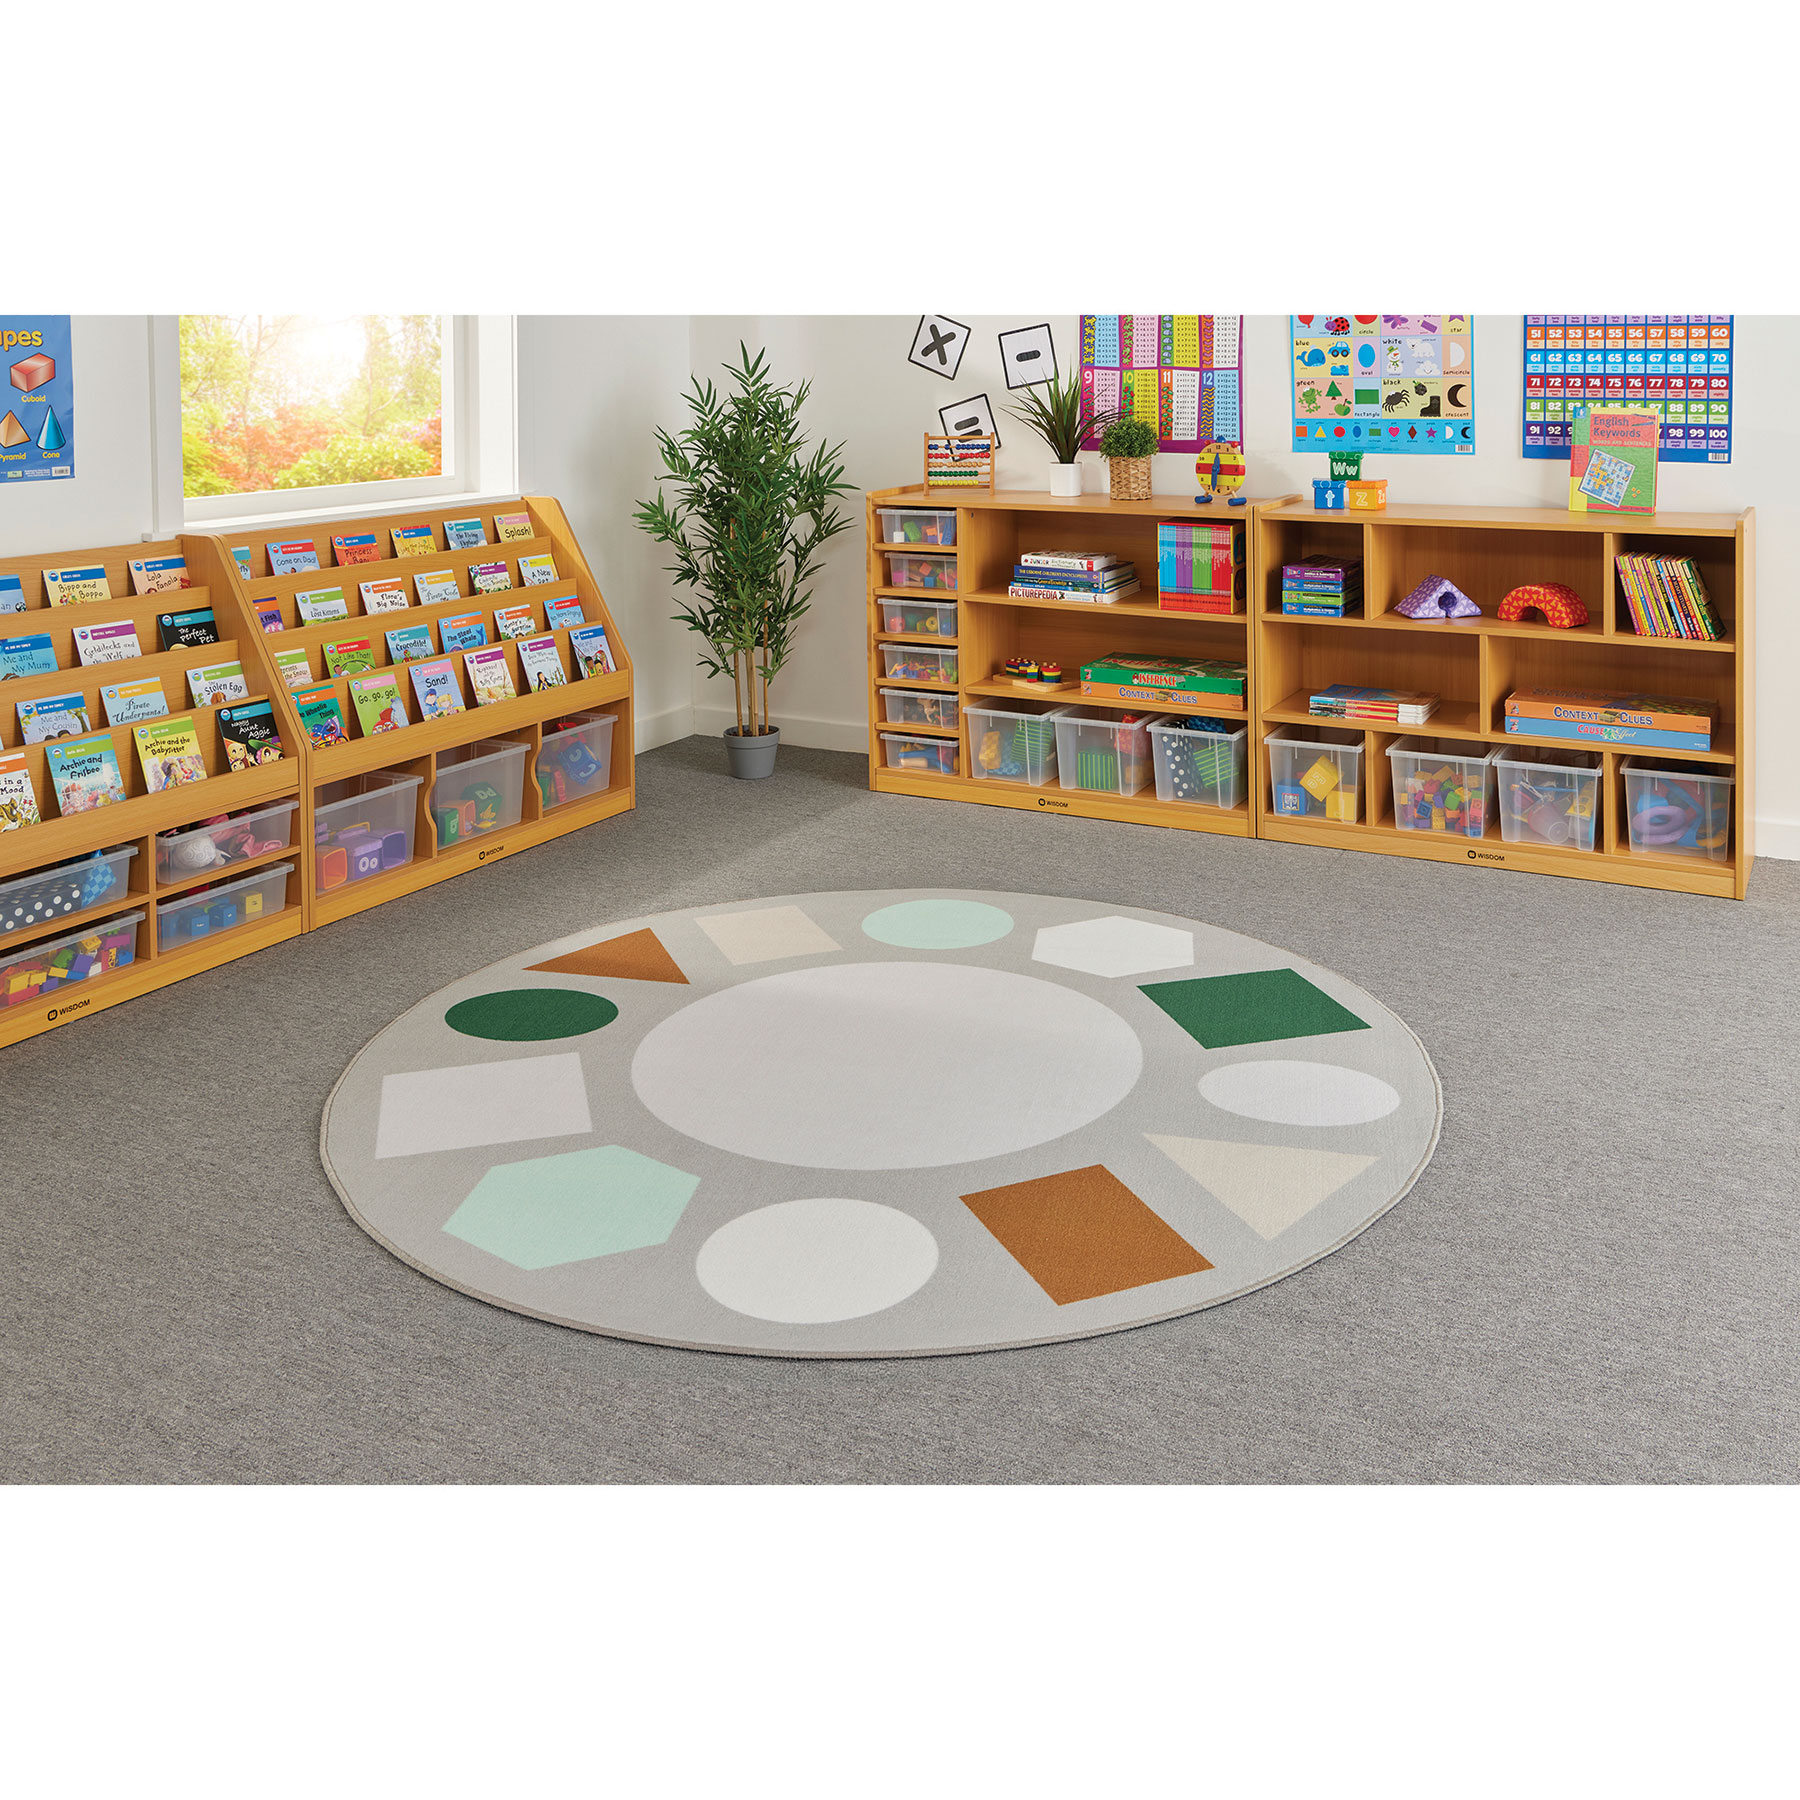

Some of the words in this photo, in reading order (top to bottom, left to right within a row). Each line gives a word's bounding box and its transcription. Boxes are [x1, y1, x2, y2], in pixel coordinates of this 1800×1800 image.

[1530, 328, 1541, 338] 51
[1548, 328, 1563, 338] 52
[1568, 328, 1582, 338] 53
[1588, 328, 1603, 338] 54
[1608, 328, 1623, 338] 55
[1628, 328, 1643, 338] 56
[1649, 328, 1664, 338] 57
[1670, 328, 1685, 338] 58
[1691, 328, 1706, 338] 59
[1711, 328, 1728, 338] 60
[1530, 353, 1541, 363] 61
[1548, 353, 1562, 363] 62
[1568, 353, 1582, 363] 63
[1587, 353, 1602, 363] 64
[1608, 353, 1622, 363] 65
[1628, 353, 1643, 363] 66
[1649, 353, 1663, 363] 67
[1669, 353, 1684, 363] 68
[1690, 353, 1706, 363] 69
[1712, 353, 1726, 363] 70
[1084, 370, 1093, 383] 9
[1122, 371, 1133, 383] 10
[1162, 371, 1171, 383] 11
[1202, 372, 1213, 385] 12
[1530, 378, 1541, 387] 71
[1548, 378, 1562, 387] 72
[1568, 378, 1582, 387] 73
[1588, 378, 1601, 387] 74
[1608, 378, 1622, 387] 75
[1628, 378, 1642, 387] 76
[1649, 378, 1662, 387] 77
[1670, 378, 1684, 387] 78
[1691, 378, 1705, 387] 79
[1711, 378, 1727, 387] 80
[21, 395, 46, 403] Cuboid
[1530, 402, 1541, 411] 81
[1548, 402, 1562, 411] 82
[1669, 403, 1684, 413] 88
[1690, 403, 1705, 413] 89
[1710, 403, 1727, 413] 90
[1593, 417, 1629, 428] English
[1529, 426, 1540, 435] 91
[1548, 426, 1562, 435] 92
[1593, 428, 1641, 438] Keywords
[1668, 428, 1684, 438] 98
[1689, 428, 1705, 438] 99
[1709, 428, 1727, 438] 100
[42, 451, 60, 459] Cone
[505, 526, 532, 539] Splash!
[344, 548, 373, 557] Princess
[276, 559, 293, 567] Come
[146, 572, 162, 582] Lola
[58, 583, 81, 593] Bippo
[82, 581, 97, 589] and
[78, 590, 103, 600] Boppo
[1010, 588, 1058, 600] PICTUREPEDIA
[310, 610, 322, 618] Lost
[322, 608, 340, 616] Kittens
[457, 628, 472, 639] Steel
[459, 634, 477, 645] Whale
[18, 651, 34, 662] and
[11, 664, 25, 674] My
[27, 661, 51, 671] Mum
[425, 675, 449, 689] Sand!
[1139, 673, 1177, 687] INFERENCE
[204, 682, 228, 695] Stolen
[229, 681, 243, 694] Egg
[385, 687, 396, 699] go!
[1119, 687, 1155, 700] CONTEXT
[1171, 692, 1198, 704] CLUES
[125, 698, 151, 711] Pirate
[53, 713, 68, 721] and
[112, 705, 165, 723] Underpants!
[319, 709, 335, 719] Thing
[1553, 706, 1599, 721] CONTEXT
[1619, 712, 1653, 726] CLUES
[52, 721, 78, 730] Cousin
[238, 723, 259, 735] Aunt
[248, 726, 271, 739] Aggie
[1577, 724, 1604, 736] CAUSE
[1614, 728, 1637, 741] Effect
[145, 738, 166, 751] Archie
[167, 736, 179, 745] and
[180, 736, 190, 744] the
[151, 745, 185, 756] Babysitter
[59, 758, 86, 773] Archie
[87, 754, 103, 763] and
[4, 777, 14, 785] in
[0, 786, 24, 795] Mood
[1477, 853, 1505, 862] WISDOM
[58, 999, 91, 1016] WISDOM
